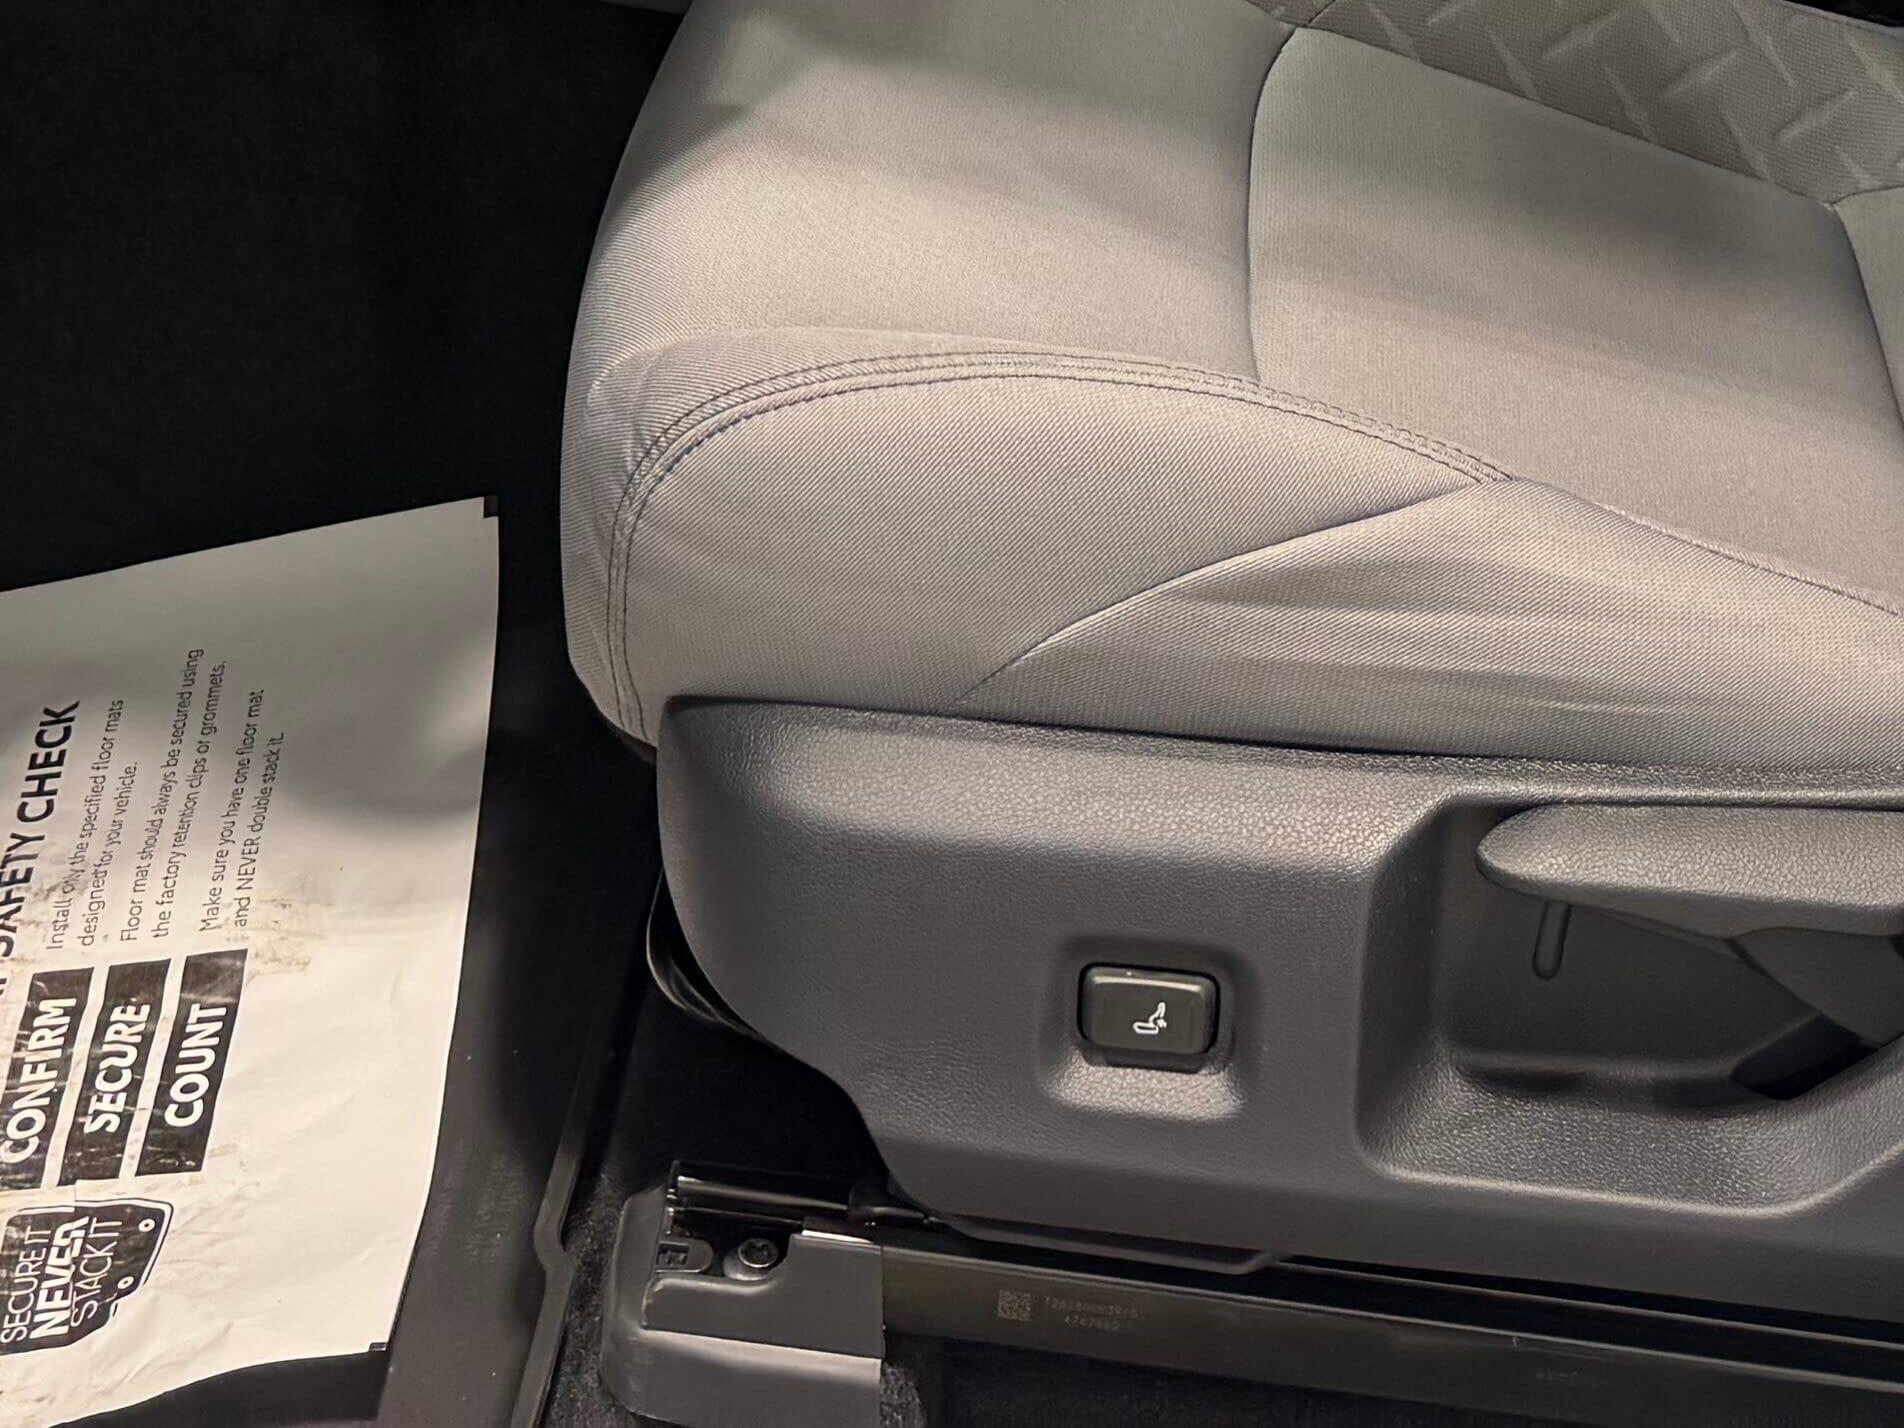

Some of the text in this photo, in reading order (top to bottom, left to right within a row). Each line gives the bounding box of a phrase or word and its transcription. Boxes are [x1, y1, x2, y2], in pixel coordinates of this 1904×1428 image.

[105, 699, 124, 734] mats
[237, 724, 258, 762] floor
[17, 700, 80, 824] CHECK
[91, 735, 114, 772] floor
[234, 760, 248, 784] one
[261, 746, 282, 786] stack
[80, 773, 106, 839] specified
[120, 648, 204, 943] Floor mat should always be secured using
[151, 660, 227, 939] the factory retention clips or grommets.
[221, 780, 245, 818] have
[247, 786, 273, 834] double
[69, 841, 90, 867] the
[77, 761, 138, 947] designed for your vehicle.
[220, 817, 236, 847] you
[212, 847, 230, 883] sure
[236, 836, 262, 891] NEVER
[46, 894, 74, 951] Install
[198, 886, 224, 932] Make
[233, 895, 252, 928] and
[0, 996, 78, 1164] CONFIRM
[83, 1003, 152, 1134] SECURE
[164, 1003, 228, 1128] COUNT
[0, 1225, 52, 1343] SECURE IT
[29, 1216, 90, 1339] NEVER
[70, 1217, 123, 1328] STACK IT
